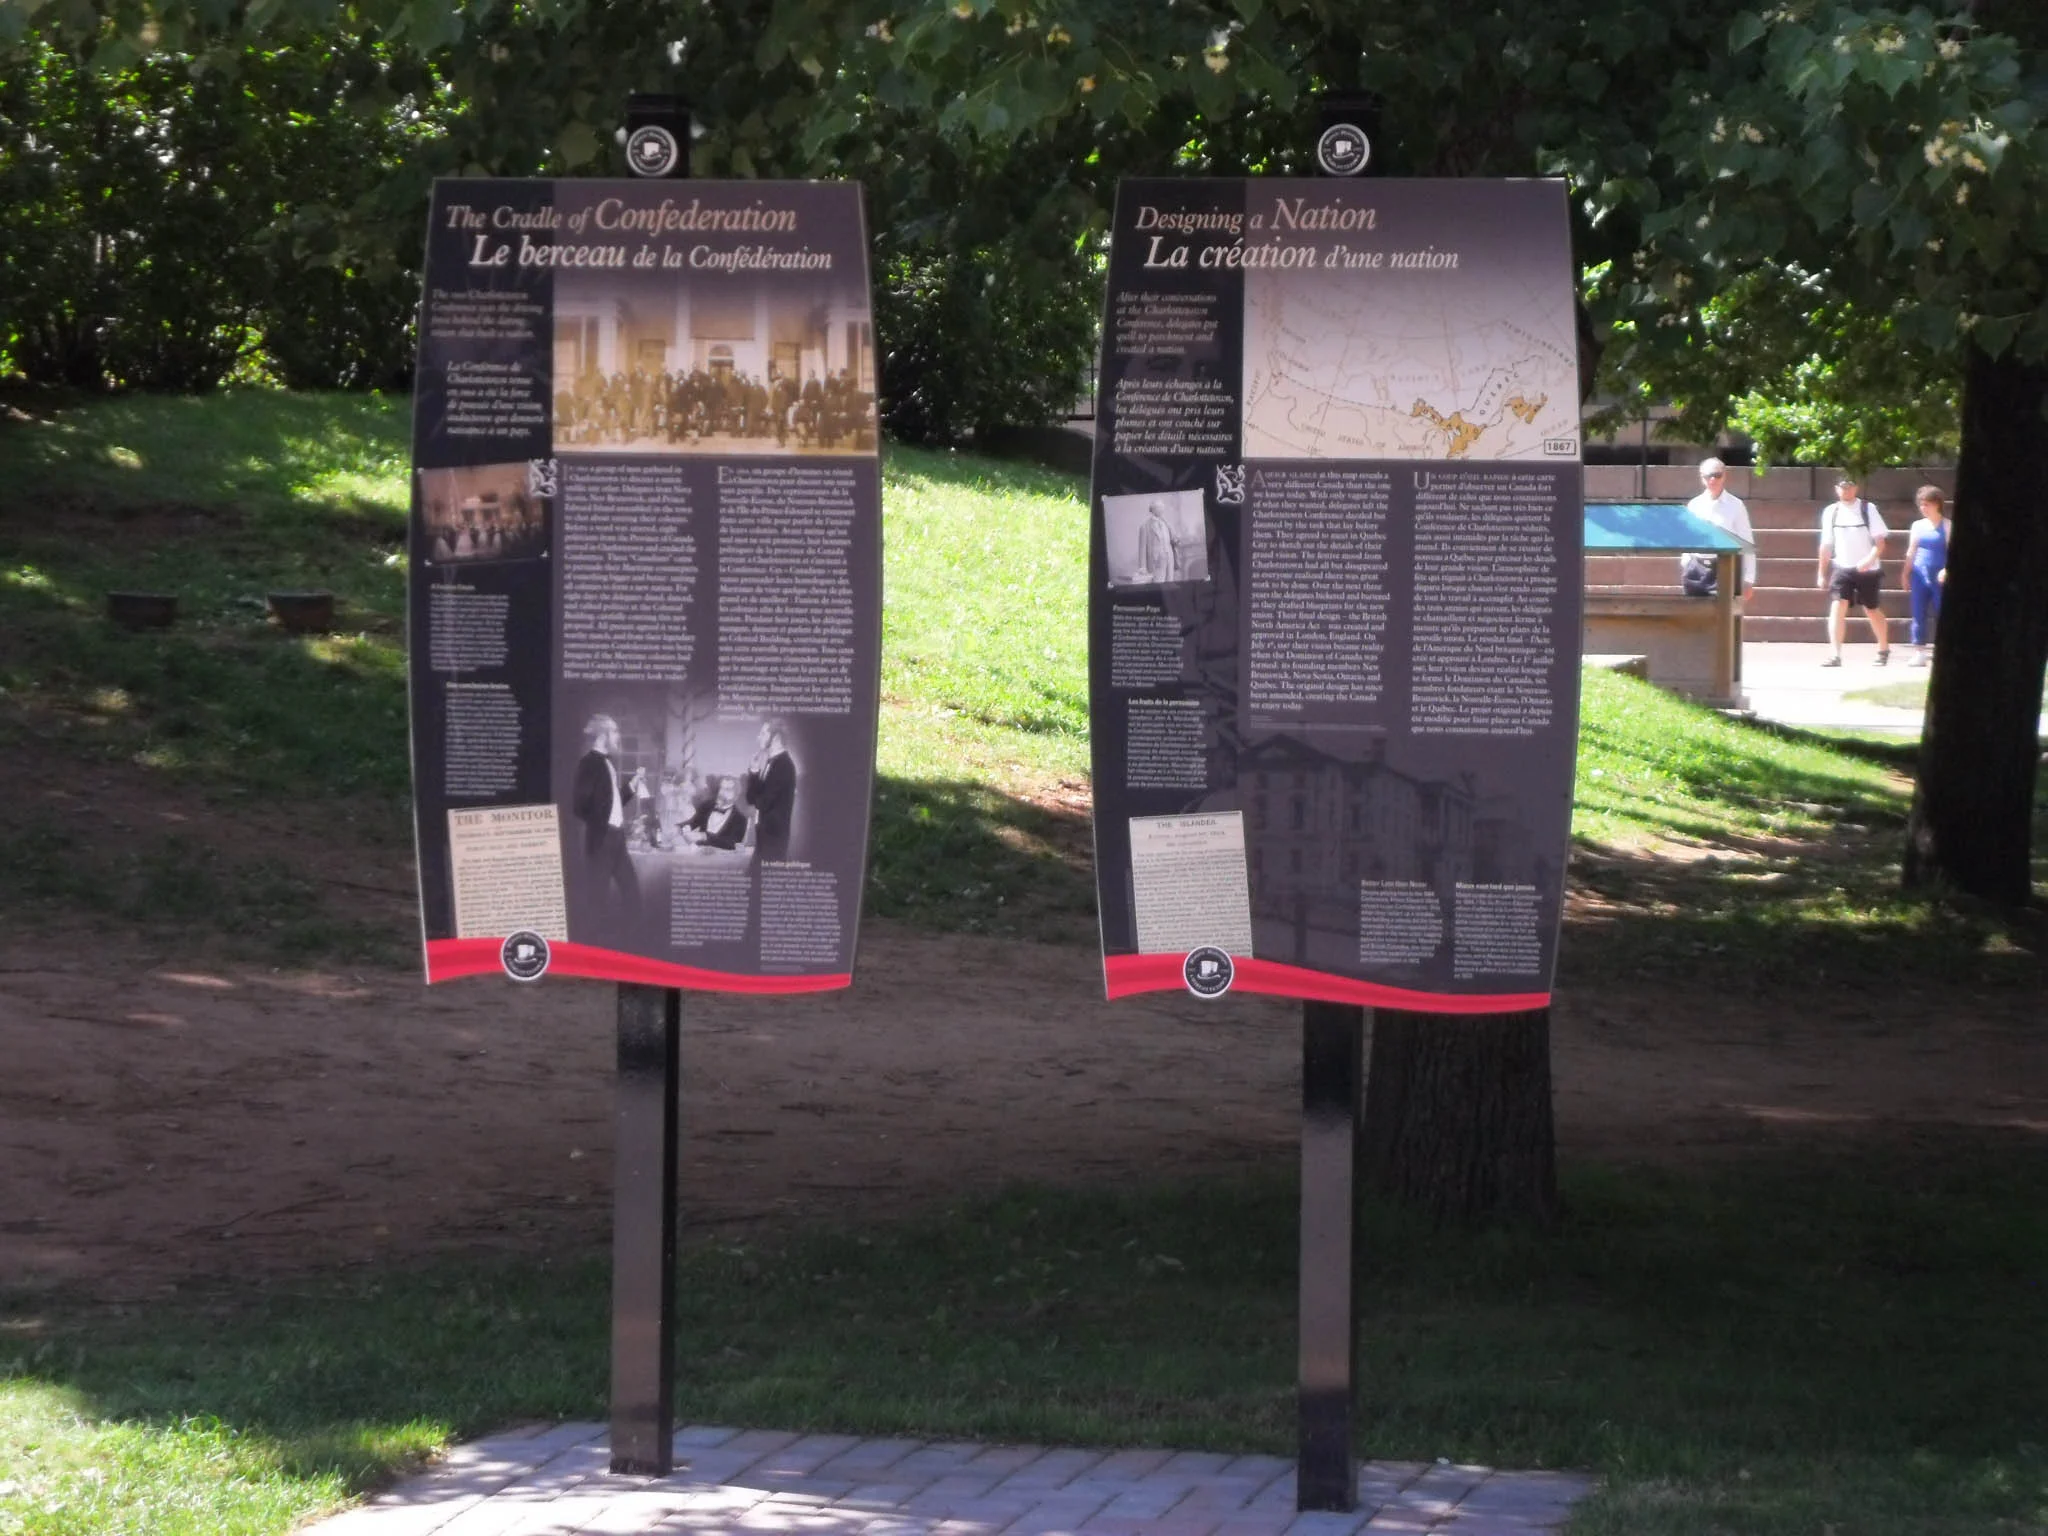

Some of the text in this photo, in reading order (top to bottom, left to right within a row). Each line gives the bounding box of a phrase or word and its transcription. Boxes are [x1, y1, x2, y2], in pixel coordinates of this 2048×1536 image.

[447, 198, 797, 236] The Cradle of Confederation
[1136, 197, 1376, 233] Designing a Nation
[469, 235, 832, 272] Le berceau de la Confédération
[1144, 236, 1459, 268] La création d'une nation
[1547, 442, 1571, 451] 1867
